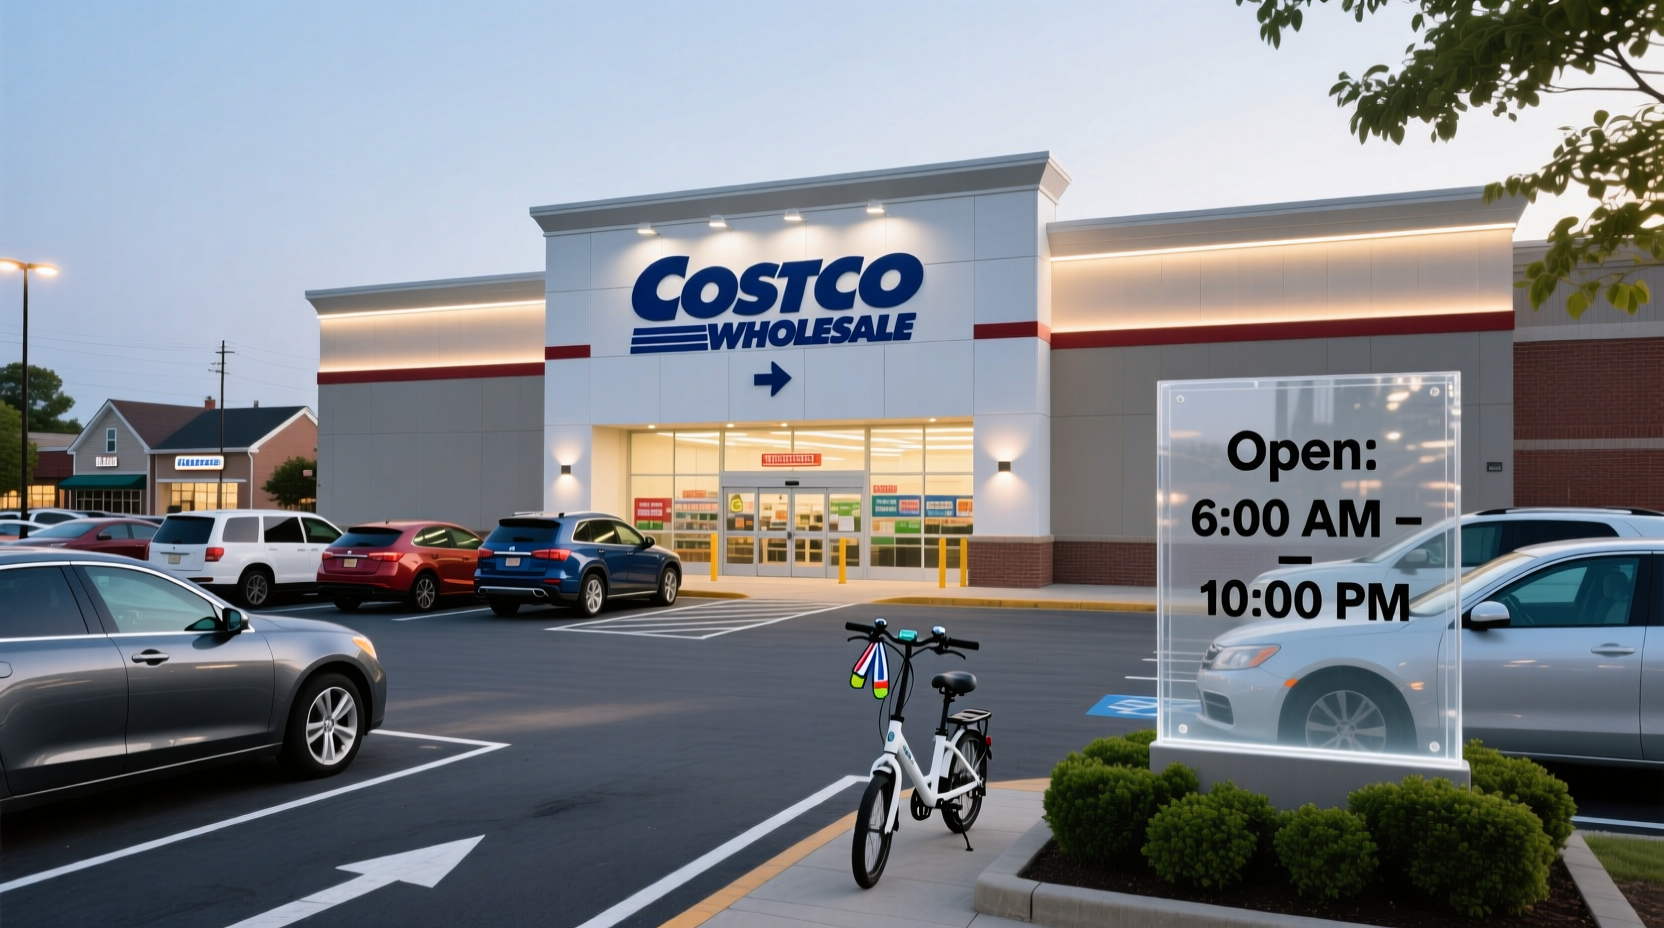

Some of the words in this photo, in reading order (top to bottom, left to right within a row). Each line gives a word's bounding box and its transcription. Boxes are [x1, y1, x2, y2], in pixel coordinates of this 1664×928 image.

[631, 252, 924, 322] COSTCO
[707, 312, 917, 351] WHOLESALE
[1227, 430, 1377, 482] Open:
[1191, 498, 1290, 538] 6:00
[1301, 499, 1381, 538] AM
[1200, 579, 1322, 620] 10:00
[1336, 582, 1410, 622] PM
